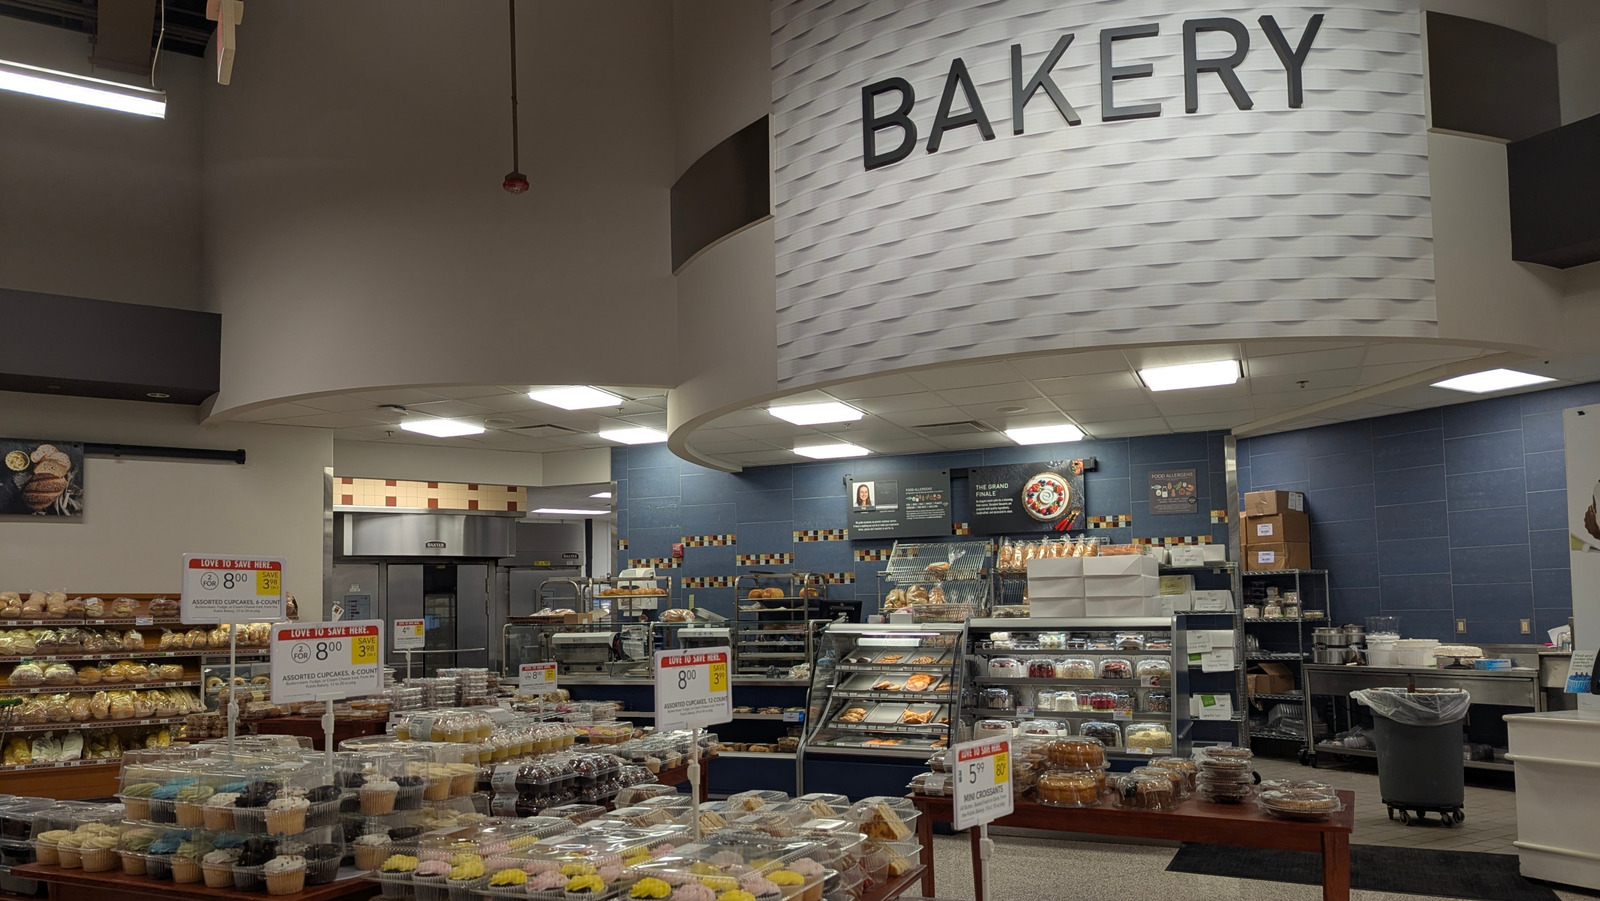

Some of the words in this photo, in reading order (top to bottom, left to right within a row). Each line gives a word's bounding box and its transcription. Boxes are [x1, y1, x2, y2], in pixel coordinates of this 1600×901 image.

[861, 14, 1325, 171] BAKERY
[222, 560, 231, 568] TO
[235, 560, 251, 568] SAVE
[254, 561, 272, 569] HERE.
[291, 629, 310, 638] LOVE
[328, 628, 346, 636] SAVE
[669, 656, 682, 665] LOVE
[685, 656, 691, 664] TO
[693, 655, 705, 663] SAVE
[282, 673, 316, 681] ASSORTED
[317, 670, 350, 678] CUPCAKES,
[664, 701, 685, 709] ASSORTED
[961, 749, 972, 759] LOVE
[974, 747, 981, 756] TO
[981, 746, 990, 755] SAVE
[996, 754, 1005, 762] SAVE
[964, 792, 975, 803] MINI
[976, 786, 1004, 800] CROISSANTS
